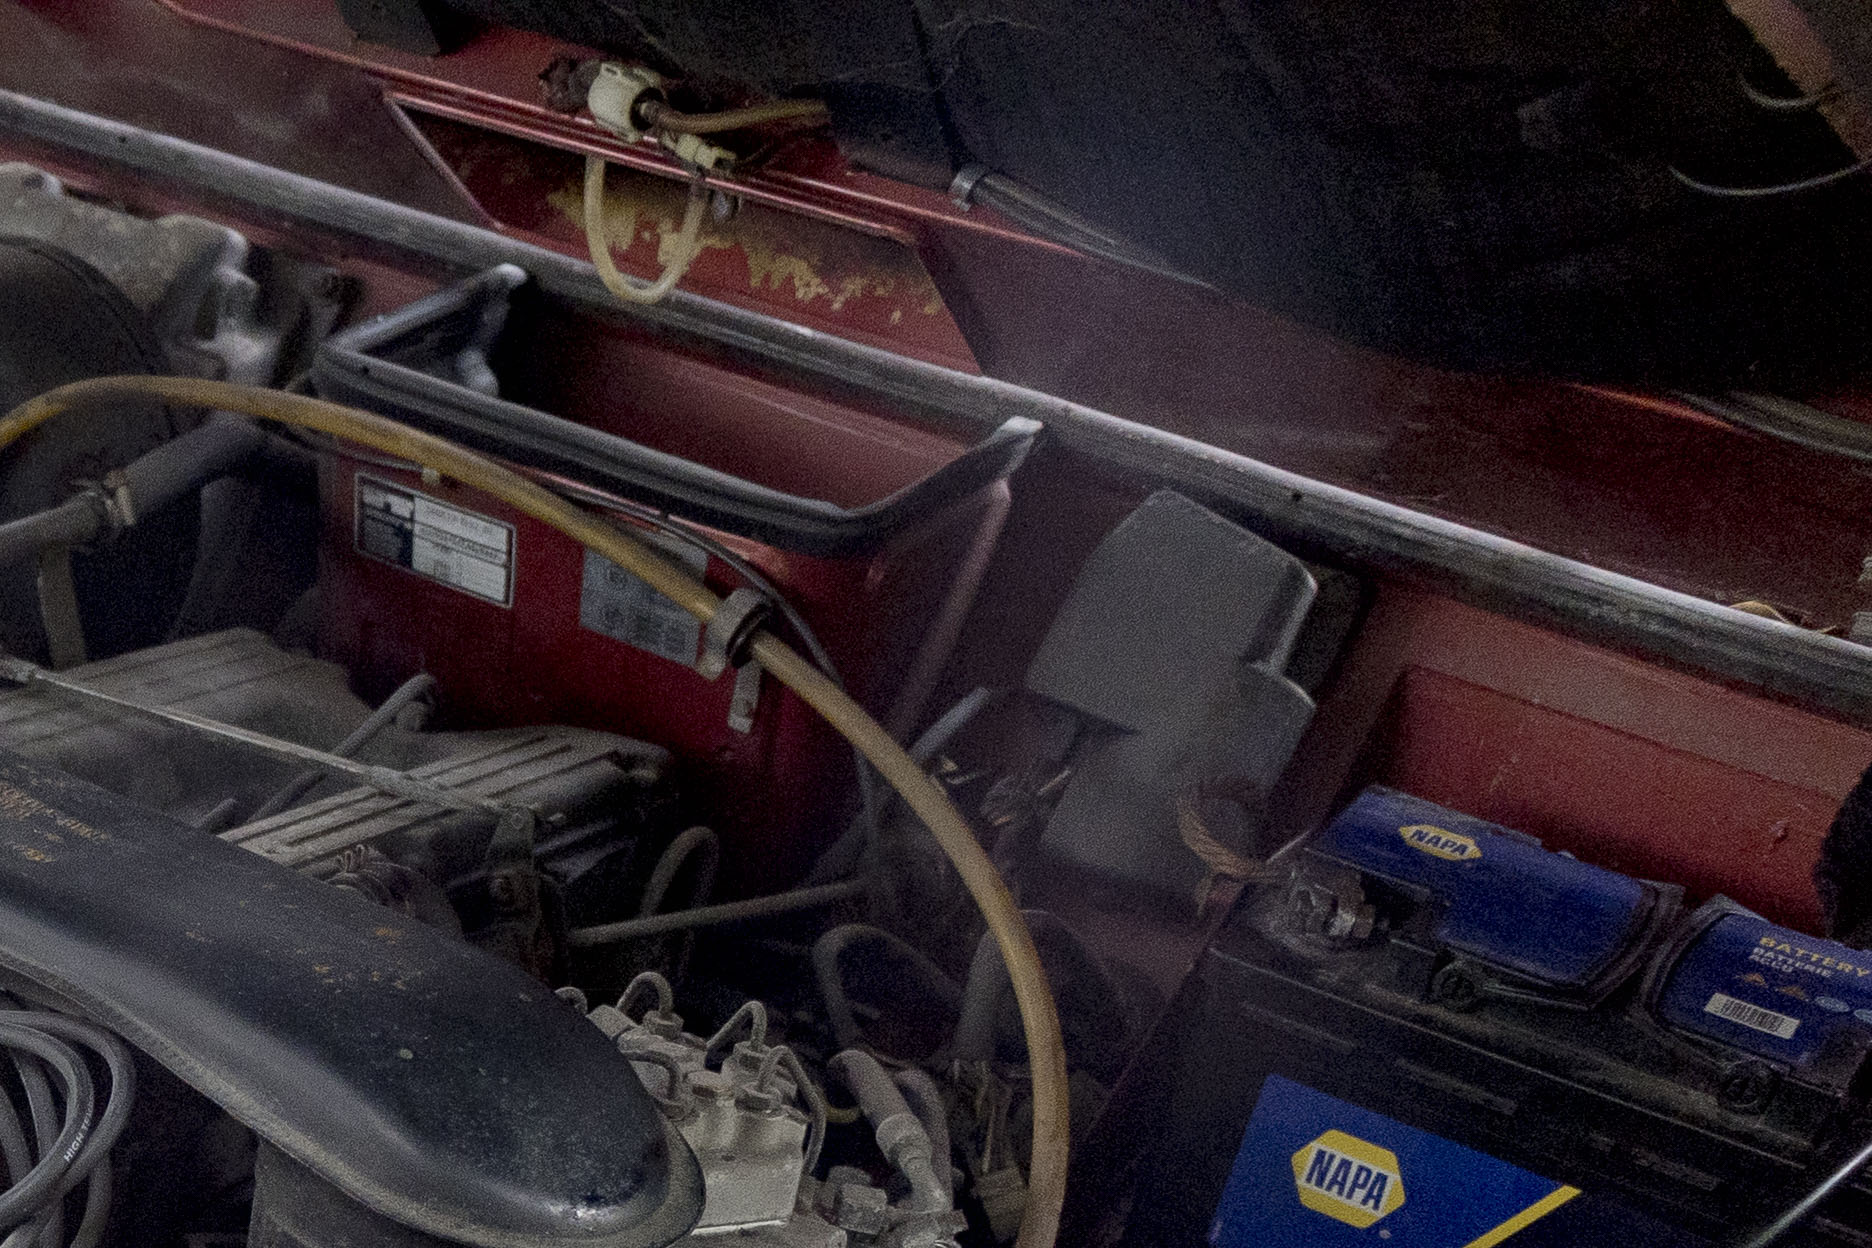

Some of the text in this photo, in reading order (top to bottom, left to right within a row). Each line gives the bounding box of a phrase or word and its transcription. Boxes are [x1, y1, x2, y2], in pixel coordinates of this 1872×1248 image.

[1410, 829, 1469, 856] NAPA
[1752, 946, 1834, 978] BATTERIE
[1759, 936, 1871, 977] BATTERY
[63, 1131, 85, 1163] HIGH
[1305, 1148, 1389, 1212] NAPA
